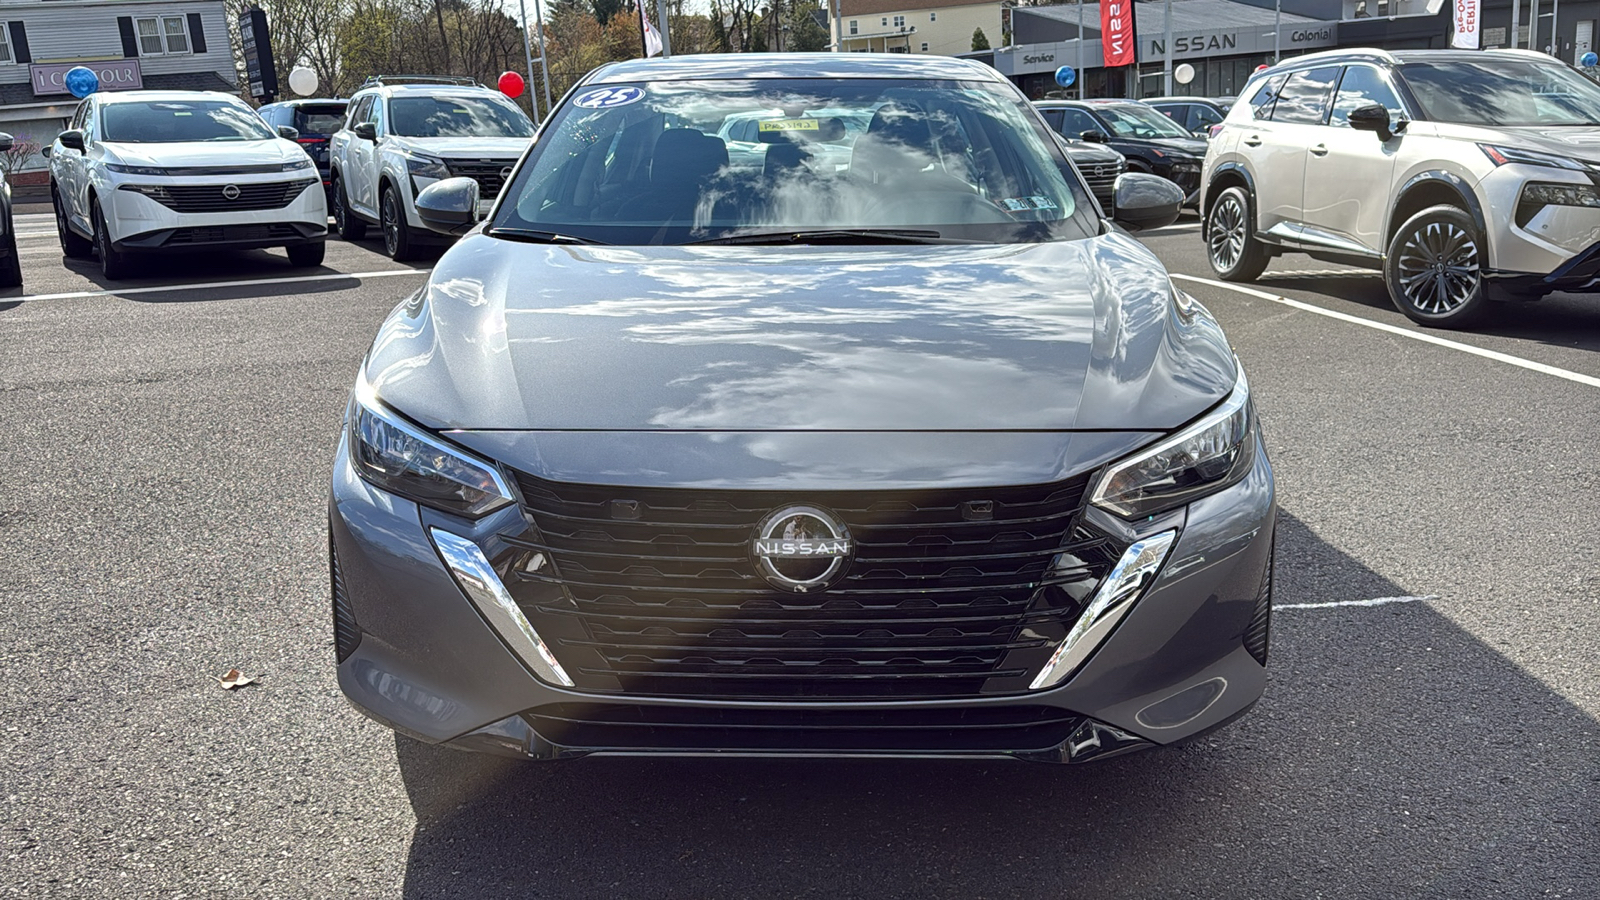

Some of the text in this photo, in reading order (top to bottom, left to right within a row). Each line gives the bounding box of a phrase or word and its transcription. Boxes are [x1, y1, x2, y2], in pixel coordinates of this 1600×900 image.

[1291, 28, 1332, 42] Colonial
[1151, 33, 1236, 56] NSSAN
[1023, 53, 1055, 65] Service
[50, 68, 134, 86] COUR
[582, 88, 635, 108] 25
[756, 541, 848, 555] NISSAN
